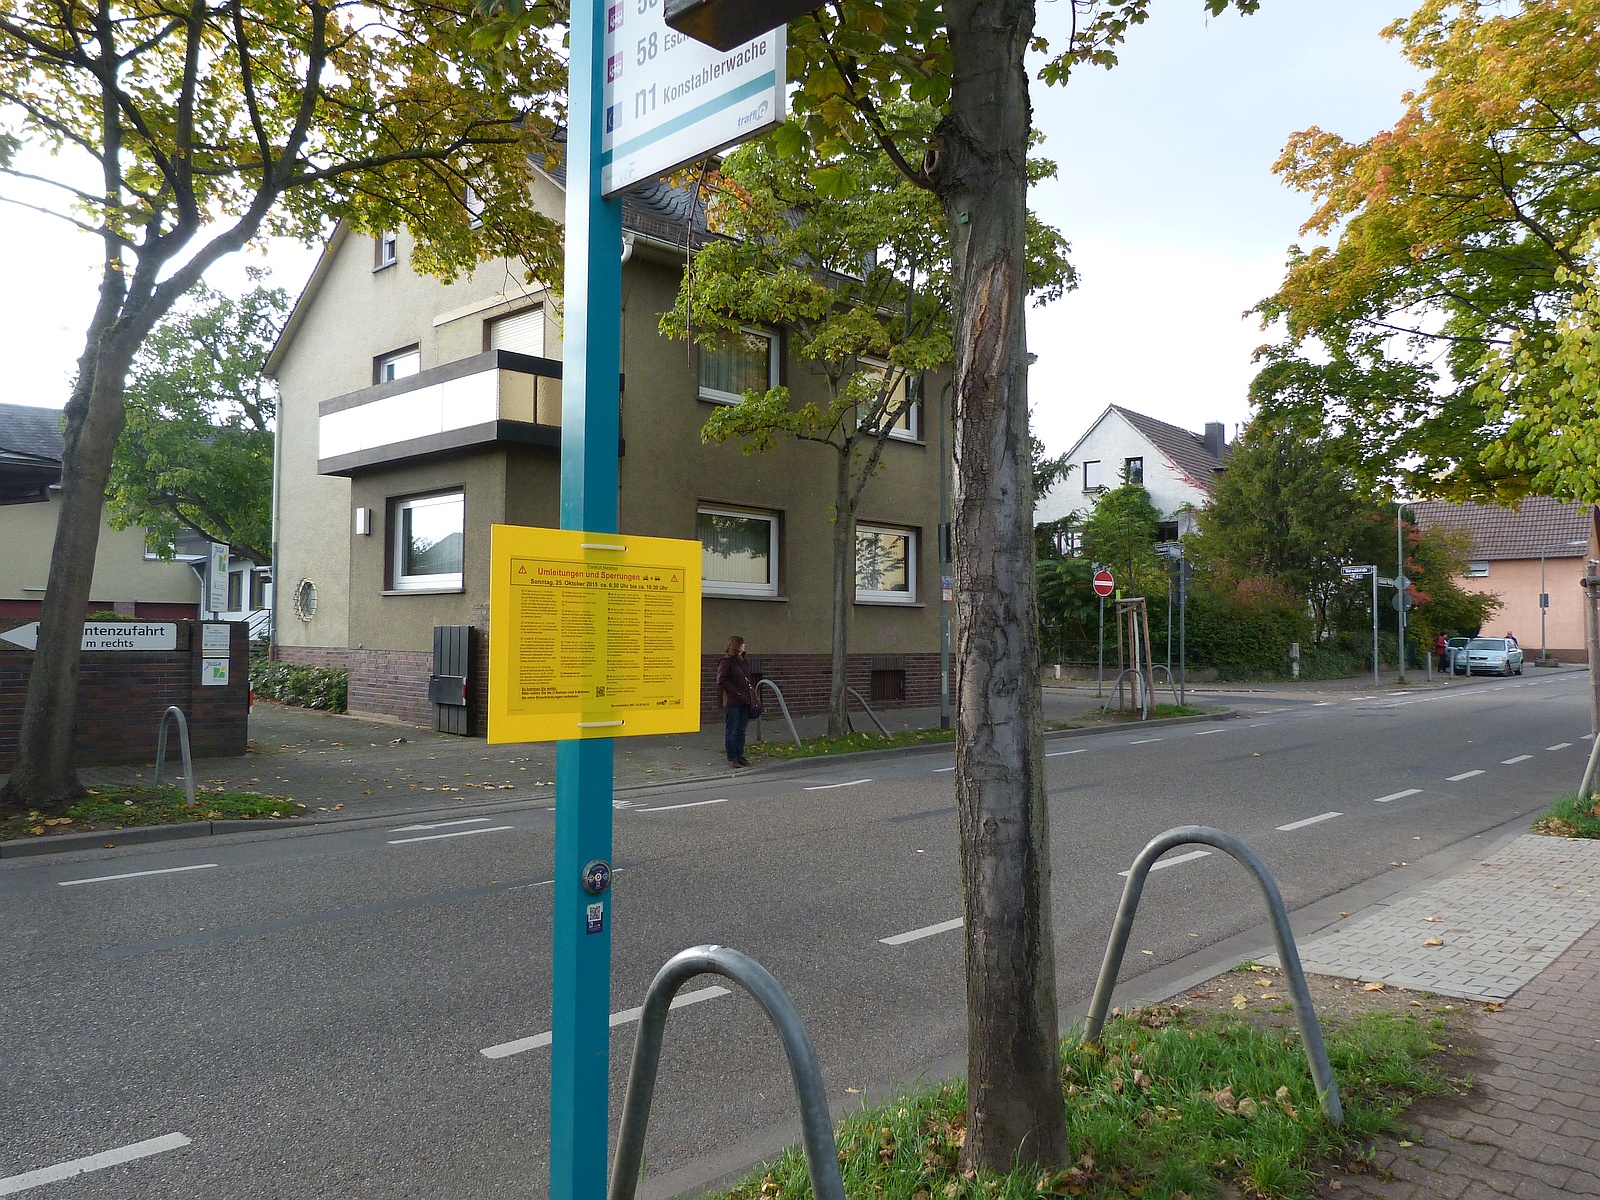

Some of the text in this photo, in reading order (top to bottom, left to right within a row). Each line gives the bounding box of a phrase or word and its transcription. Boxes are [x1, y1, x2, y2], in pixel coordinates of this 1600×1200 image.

[636, 31, 658, 67] 58
[635, 40, 767, 119] n1 Konstablerwache
[537, 567, 584, 579] Umleitungen
[600, 571, 640, 581] Sperrungen
[101, 639, 134, 648] rechts
